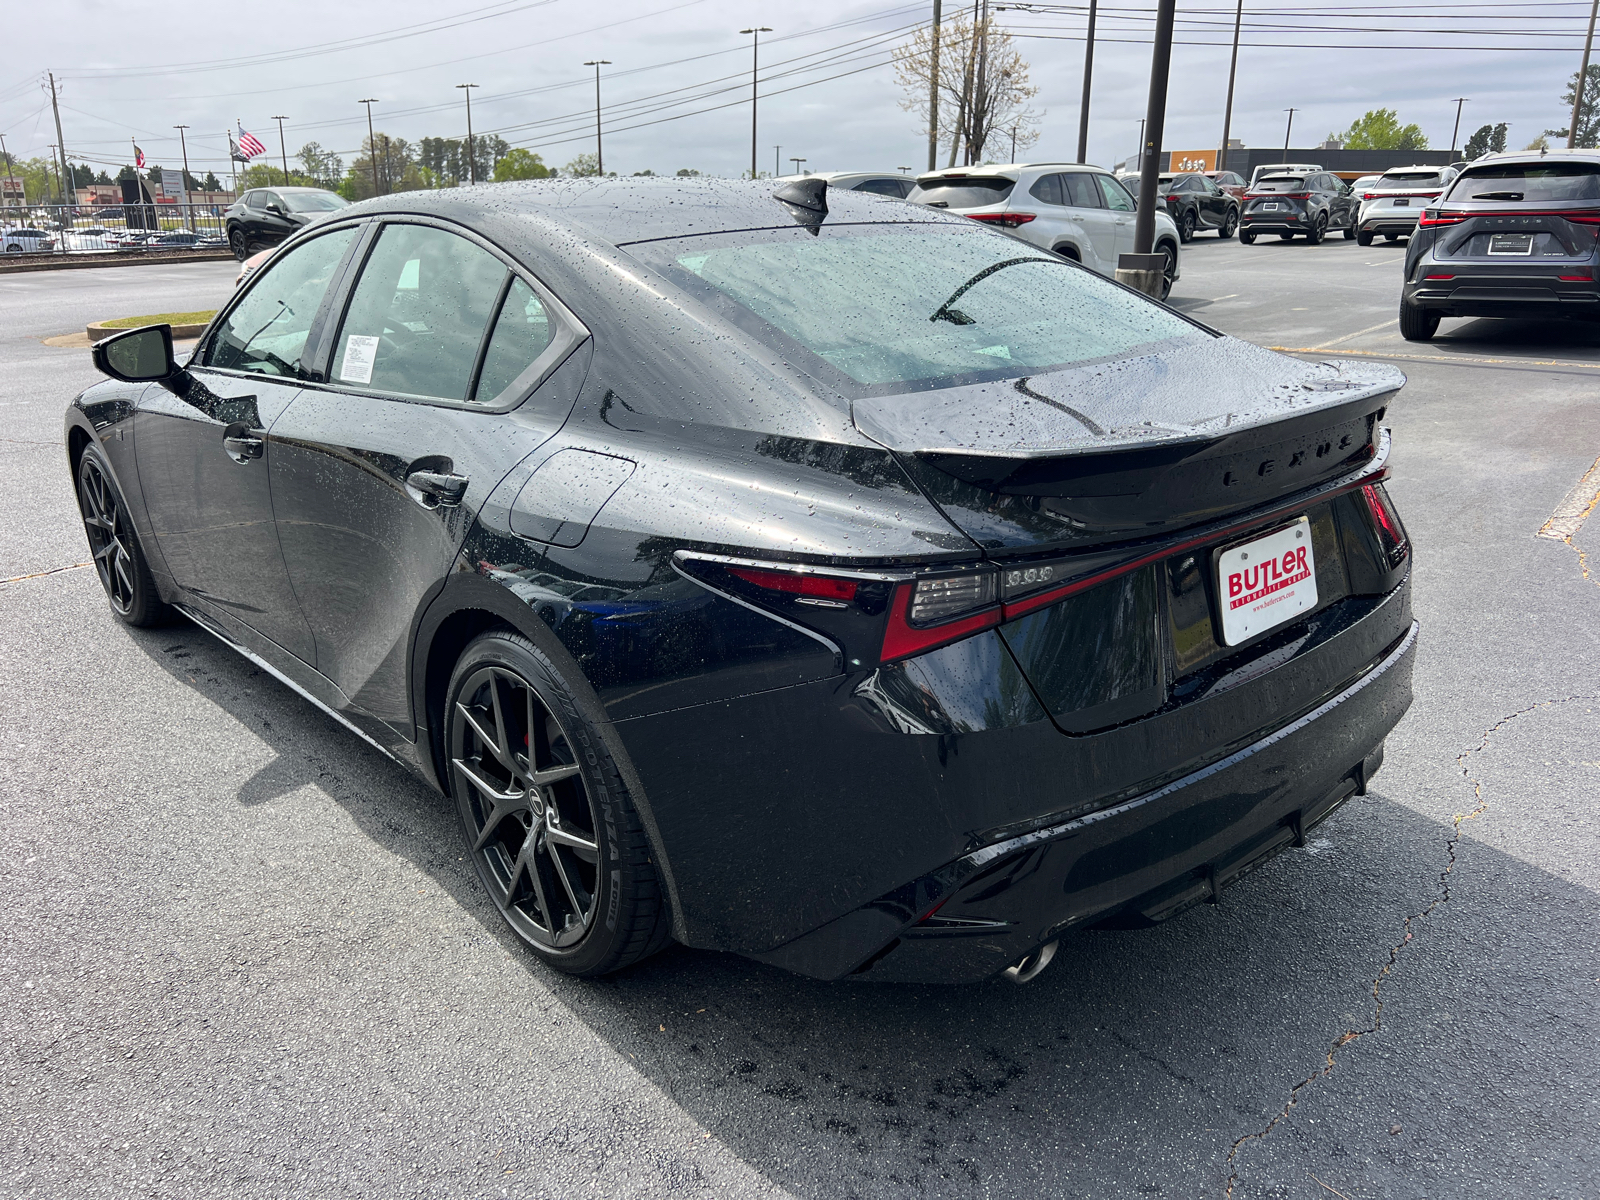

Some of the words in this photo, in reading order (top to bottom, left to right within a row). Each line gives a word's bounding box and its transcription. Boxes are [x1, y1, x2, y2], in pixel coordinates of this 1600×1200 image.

[1178, 157, 1206, 172] Jeep
[1223, 434, 1354, 487] LEXUS
[1230, 583, 1281, 610] AUTOMOTIVE
[1287, 569, 1311, 585] GROUP
[1252, 590, 1296, 613] www.butlercars.com
[576, 729, 621, 861] POTENZA
